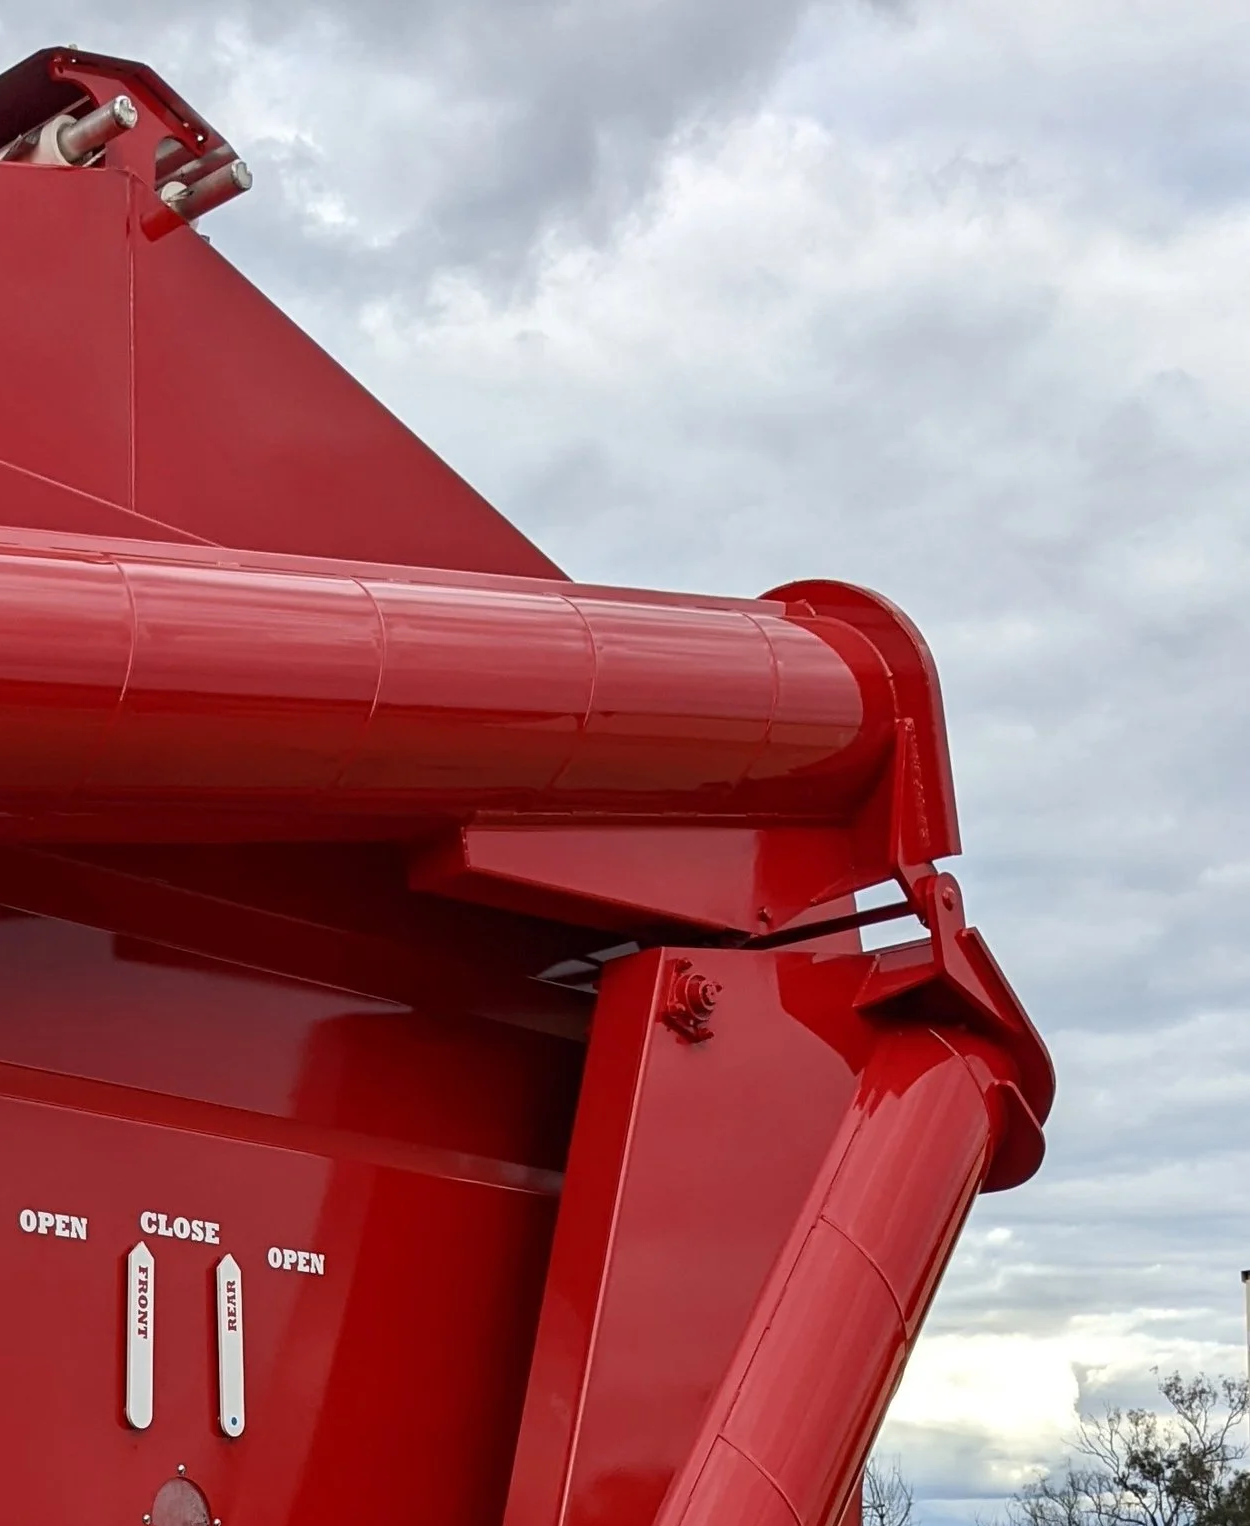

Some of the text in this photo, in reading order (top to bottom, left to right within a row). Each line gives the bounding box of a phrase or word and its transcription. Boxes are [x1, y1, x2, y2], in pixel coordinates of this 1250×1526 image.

[19, 1208, 88, 1240] OPEN
[140, 1211, 220, 1245] CLOSE
[267, 1246, 325, 1275] OPEN
[137, 1265, 149, 1339] FRONT
[227, 1280, 238, 1332] REAR
